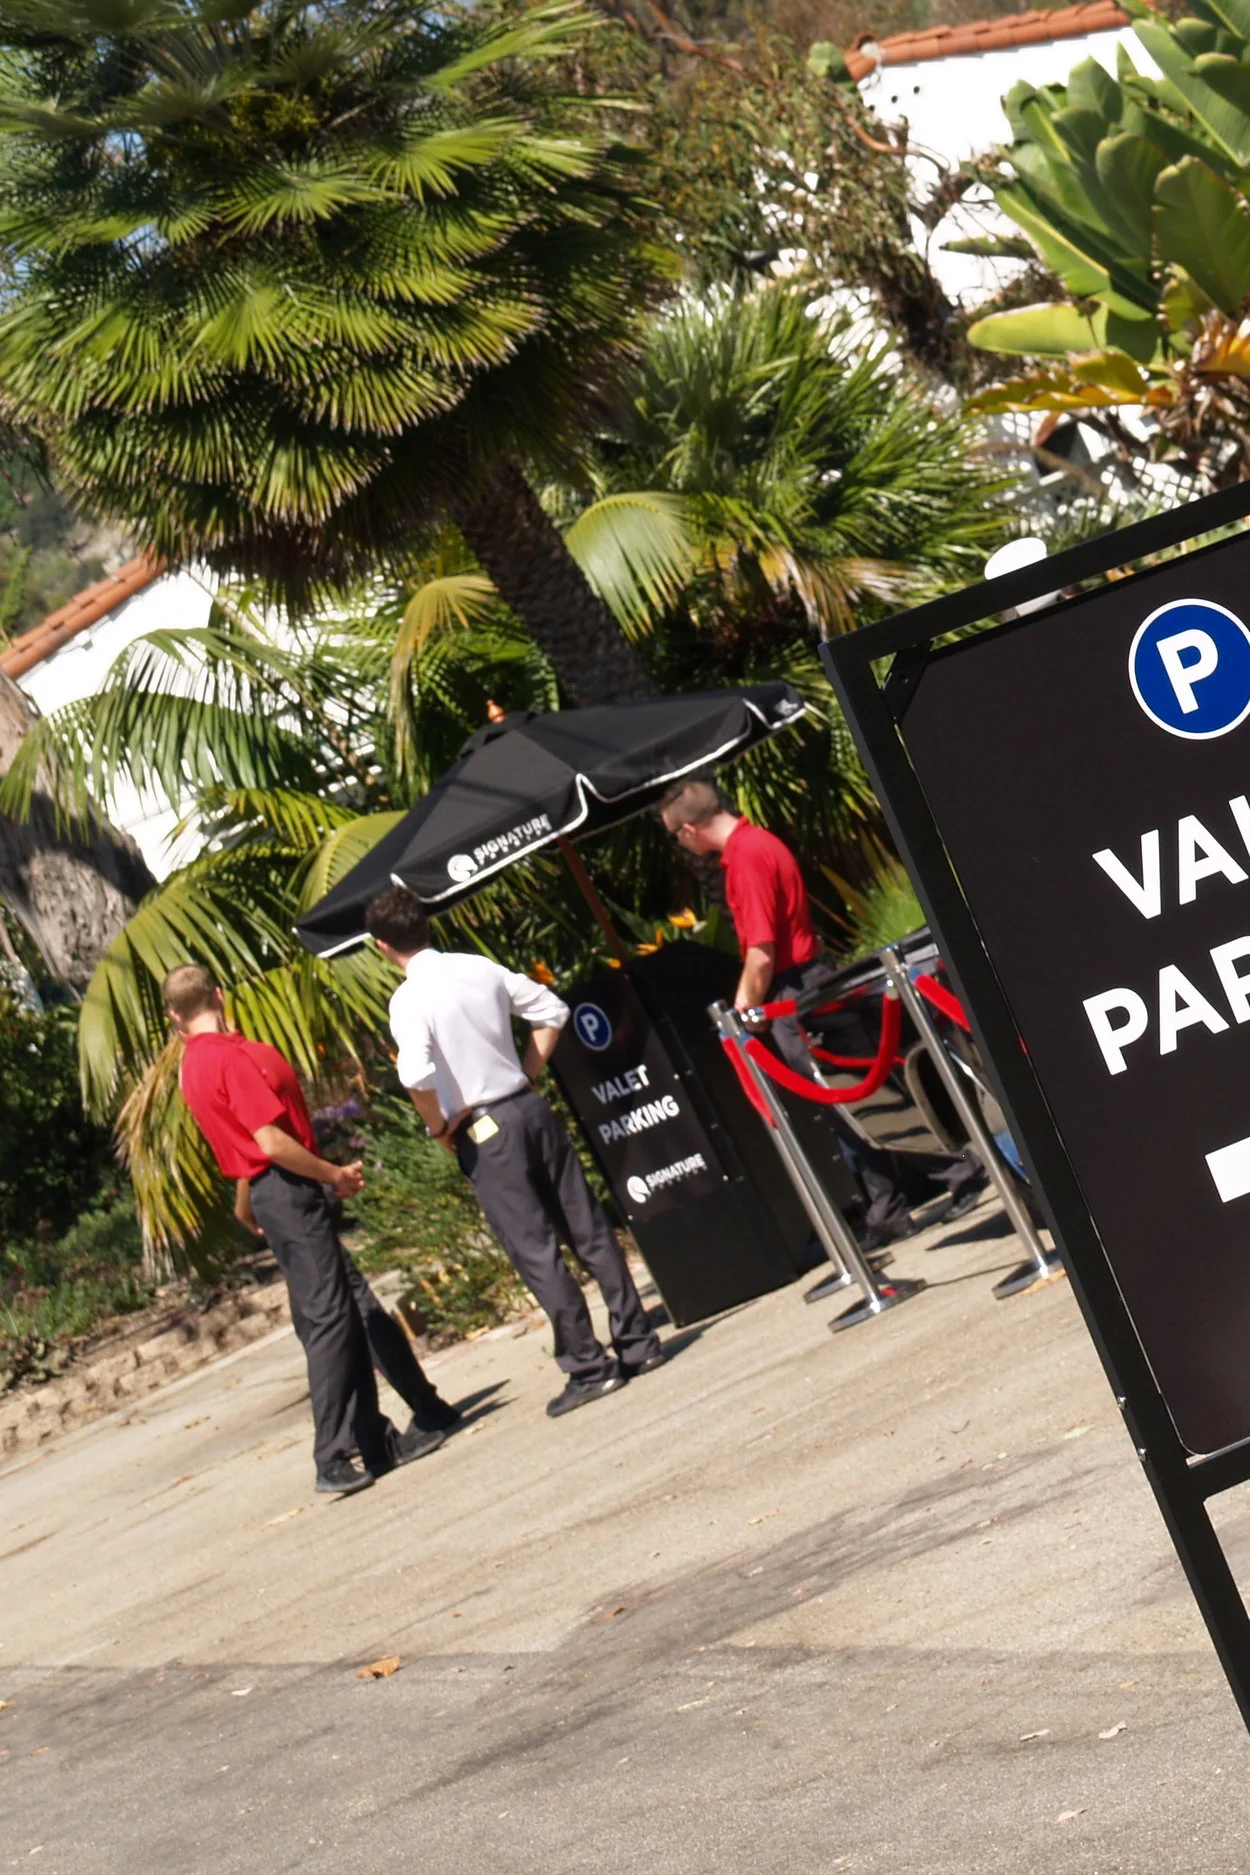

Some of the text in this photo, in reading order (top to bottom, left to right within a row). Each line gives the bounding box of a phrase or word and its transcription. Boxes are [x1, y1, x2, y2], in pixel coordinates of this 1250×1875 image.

[1156, 628, 1219, 715] P
[473, 813, 552, 857] SIGNATURE
[580, 1012, 599, 1042] P
[592, 1064, 650, 1104] VALET
[598, 1094, 680, 1144] PARKING
[645, 1153, 706, 1189] SIGNATURE
